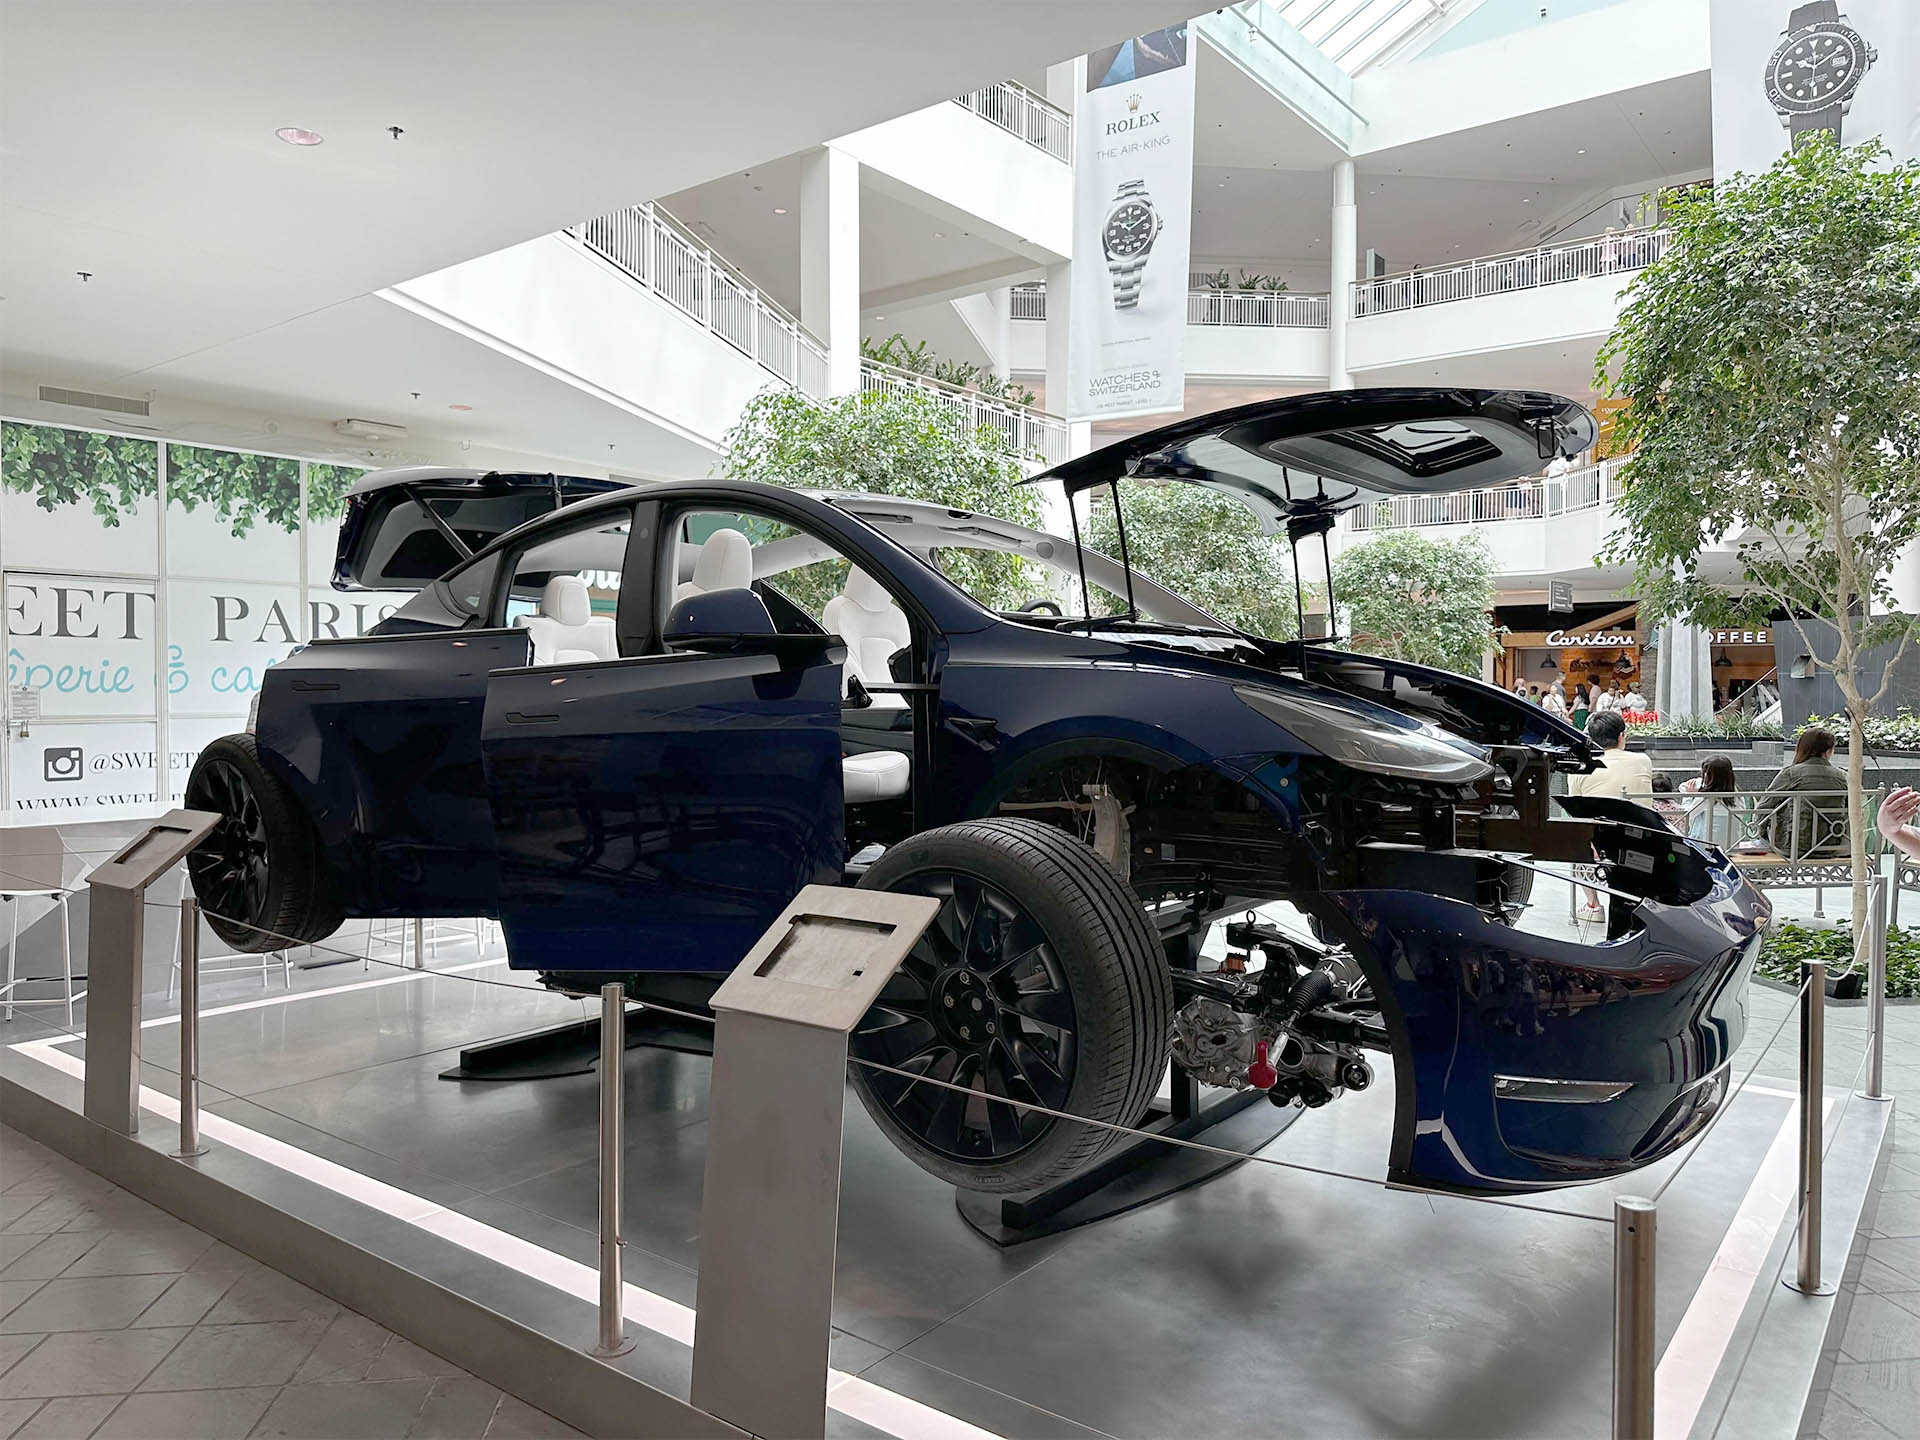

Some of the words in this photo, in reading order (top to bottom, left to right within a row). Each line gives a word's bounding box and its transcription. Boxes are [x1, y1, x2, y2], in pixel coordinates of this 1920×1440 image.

[1106, 111, 1160, 136] ROLEX
[1096, 148, 1119, 160] THE
[1120, 135, 1170, 156] AIR-KING
[1088, 380, 1161, 397] SWITZERLAND
[1089, 371, 1150, 388] WATCHES
[1545, 630, 1635, 646] Caribou
[211, 658, 276, 692] ca
[88, 751, 200, 774] @SWEET
